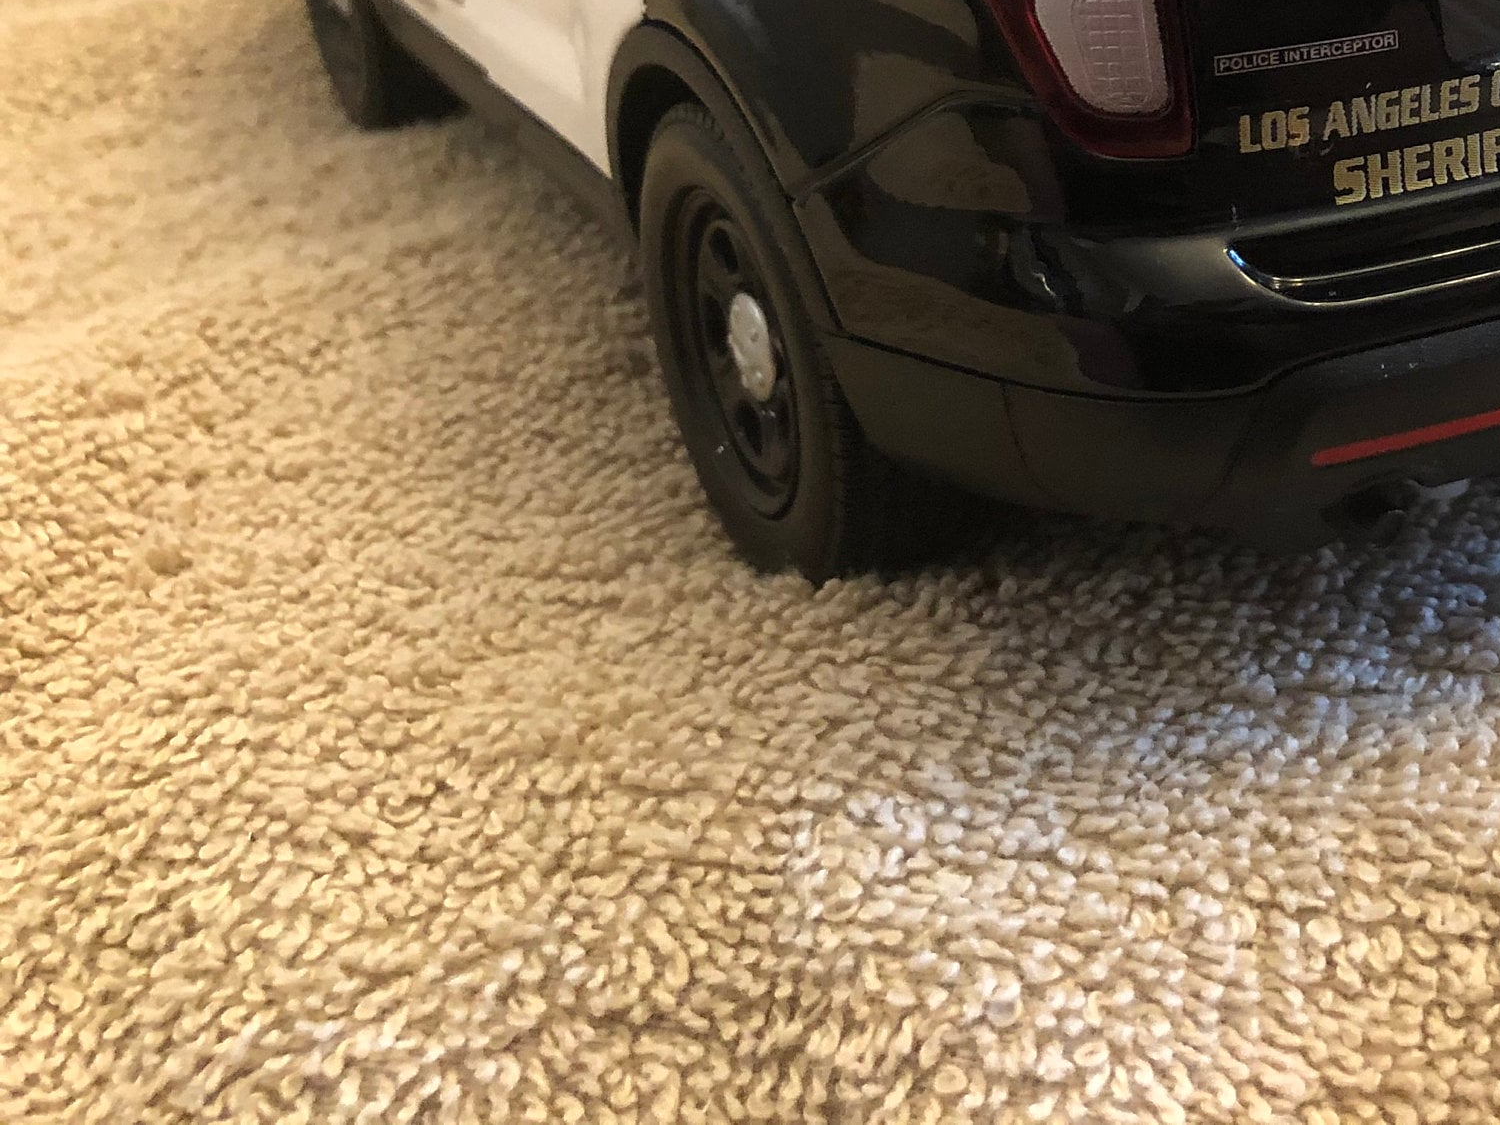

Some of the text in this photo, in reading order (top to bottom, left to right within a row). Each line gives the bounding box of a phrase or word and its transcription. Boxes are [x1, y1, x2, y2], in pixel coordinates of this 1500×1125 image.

[1219, 32, 1395, 72] POLICE INTERCEPTOR
[1239, 106, 1310, 153] LOS
[1322, 74, 1481, 141] ANGELES
